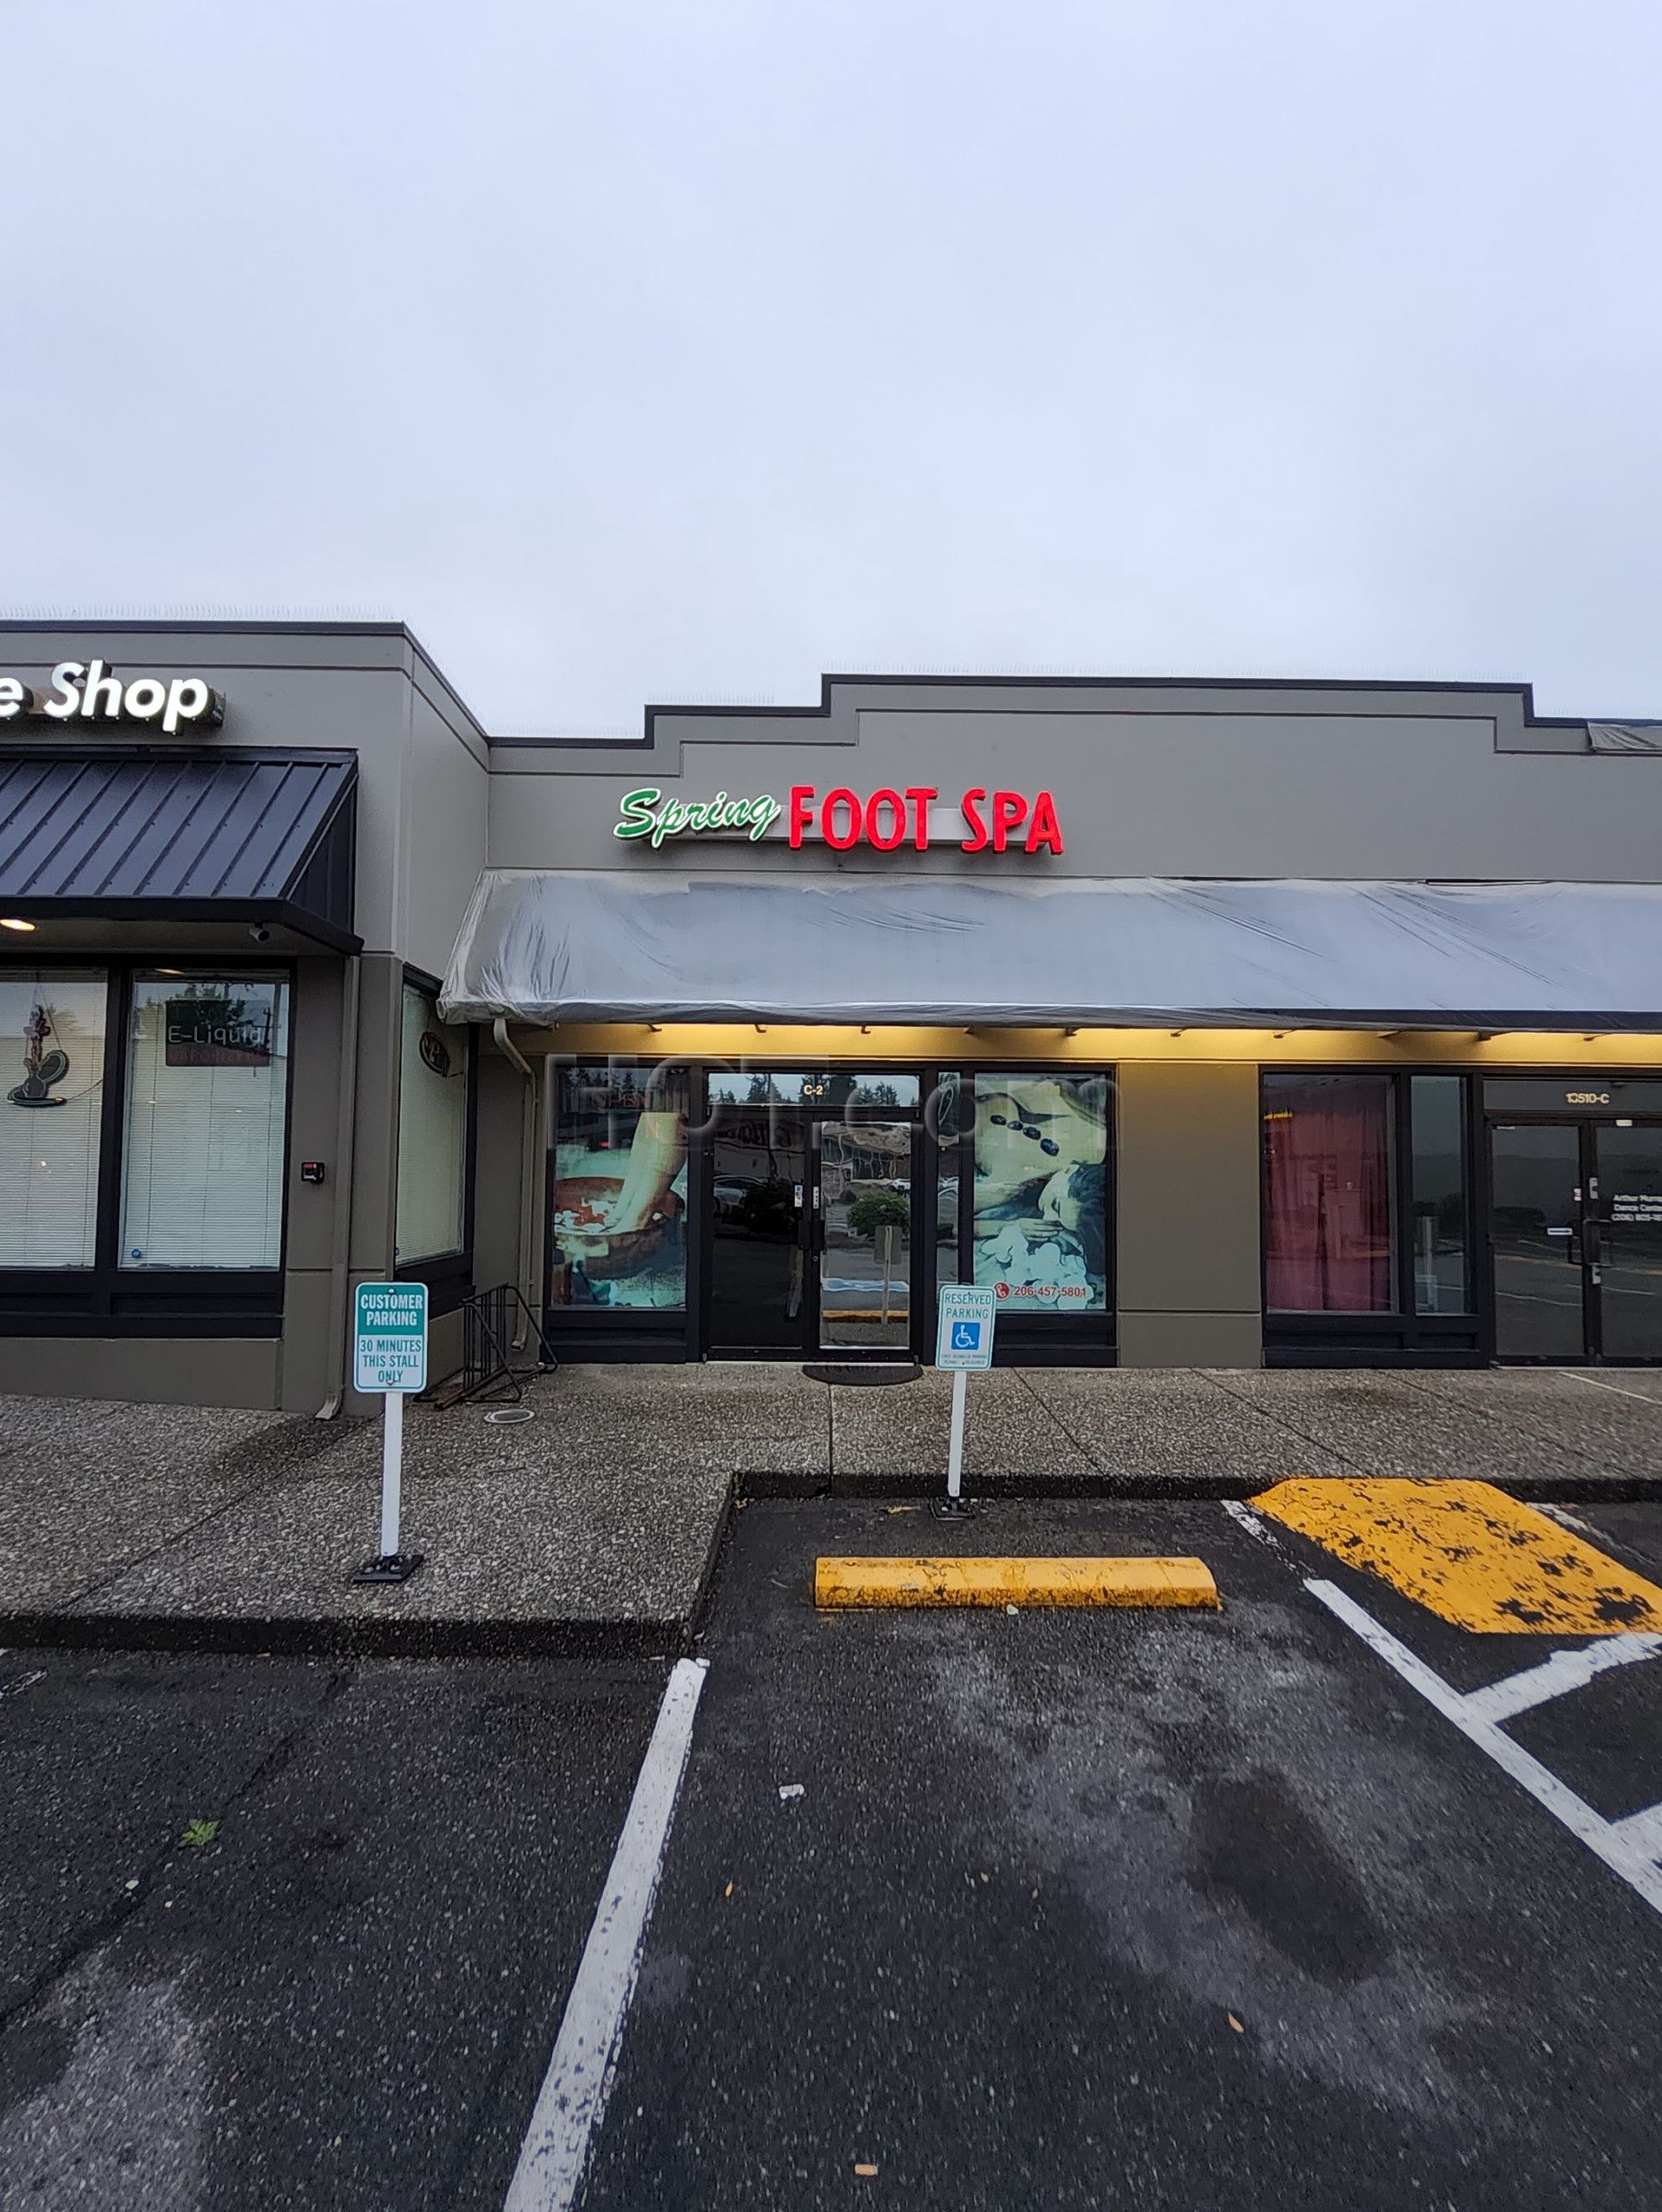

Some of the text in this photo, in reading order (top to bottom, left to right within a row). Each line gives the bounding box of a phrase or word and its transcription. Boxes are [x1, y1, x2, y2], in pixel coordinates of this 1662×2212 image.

[43, 659, 209, 733] Shop
[613, 785, 1064, 855] Spring FOOT SPA
[168, 1025, 266, 1046] E-Liquid
[804, 1084, 824, 1096] C-2
[360, 1294, 423, 1309] CUSTOMER
[945, 1293, 991, 1305] RESERVED
[366, 1311, 417, 1326] PARKING
[946, 1307, 989, 1319] PARKING
[360, 1339, 422, 1352] 30 MINUTES
[363, 1355, 419, 1367] THIS STALL
[378, 1370, 404, 1382] ONLY
